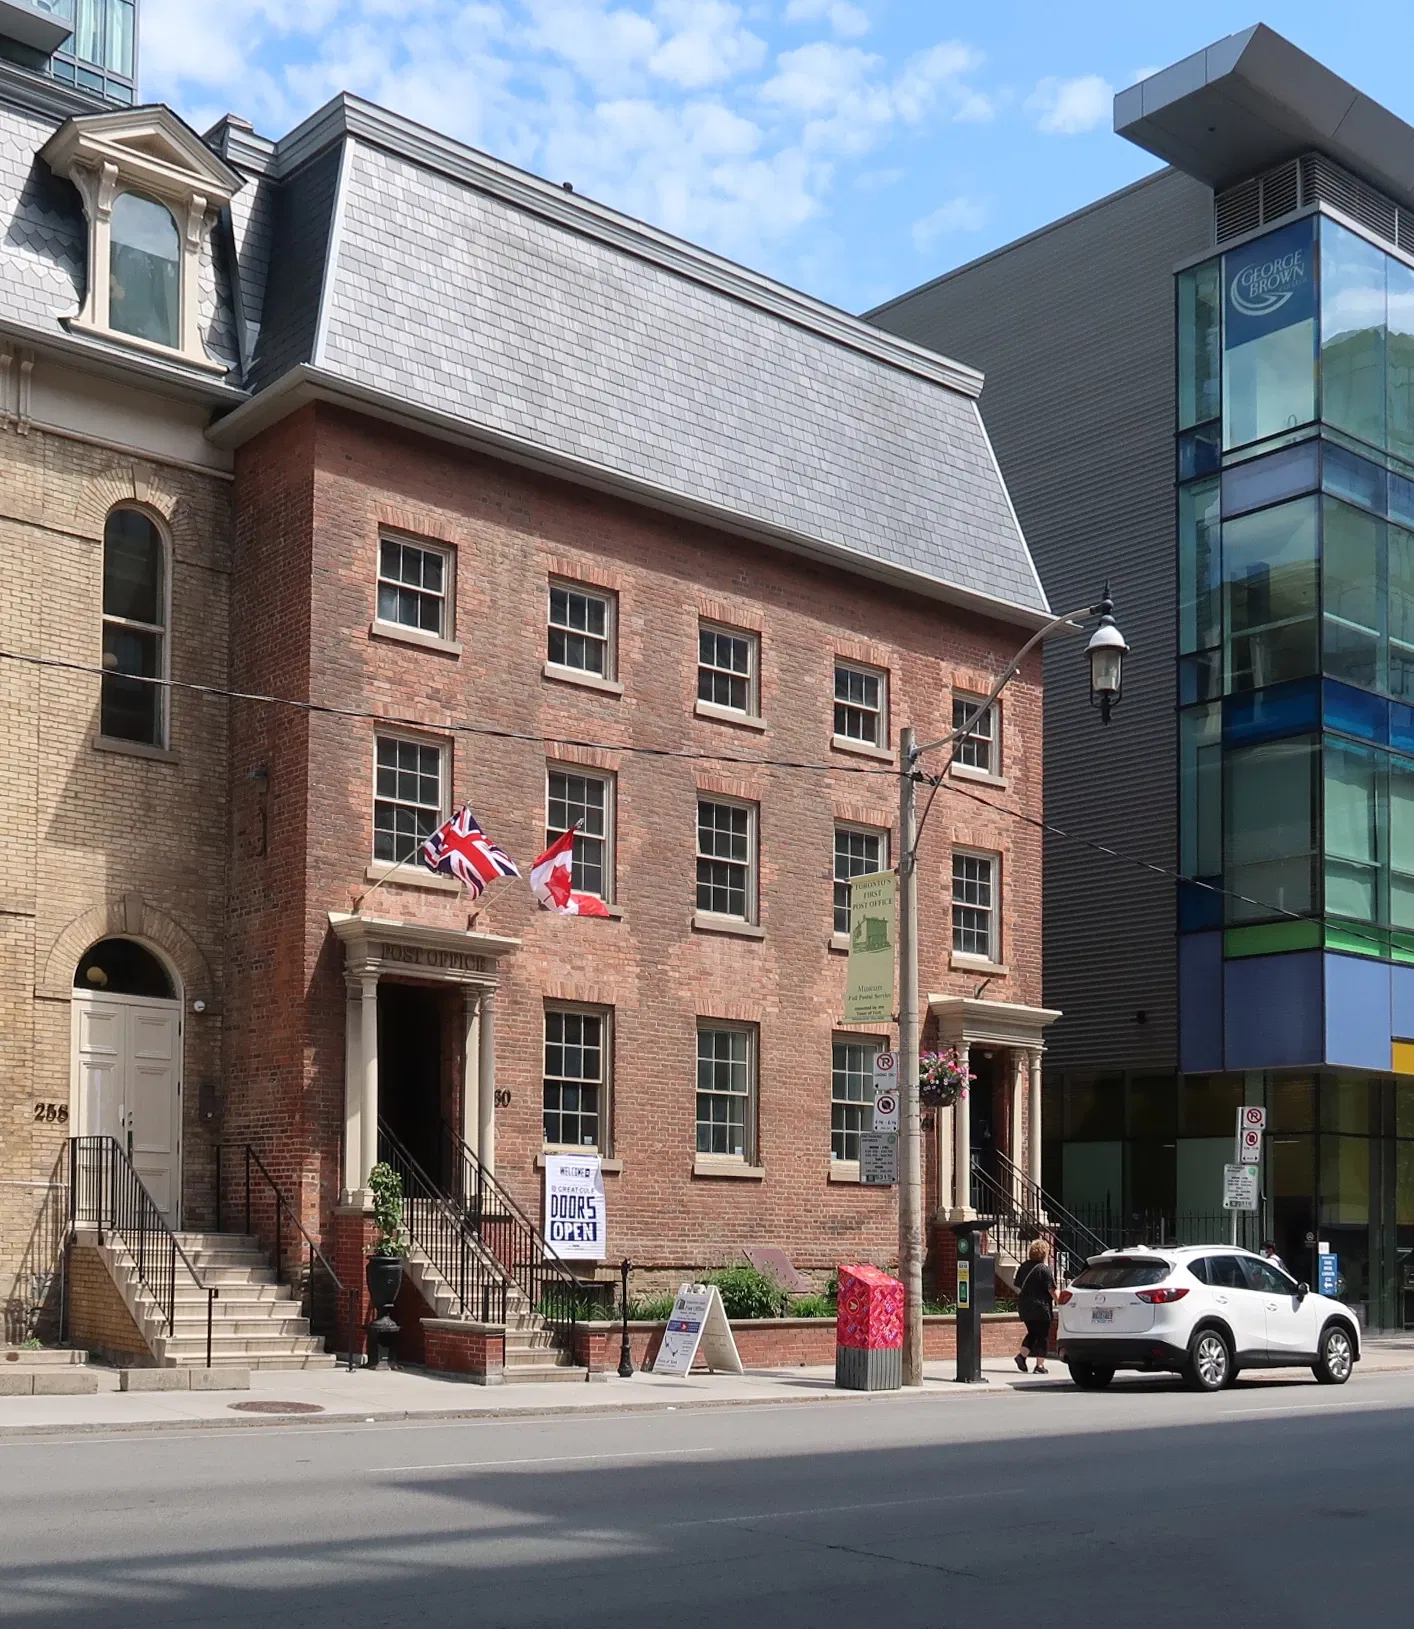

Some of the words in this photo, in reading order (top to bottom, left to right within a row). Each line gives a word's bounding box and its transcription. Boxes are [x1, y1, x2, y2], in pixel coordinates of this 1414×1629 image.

[1241, 249, 1303, 286] GEORGE
[1249, 262, 1305, 298] BROWN
[852, 902, 868, 911] POST
[868, 898, 892, 908] OFFICE
[863, 889, 882, 899] FIRST
[382, 942, 422, 964] POST
[427, 950, 486, 972] OFFICE
[34, 1102, 69, 1124] 258
[560, 1167, 585, 1177] WELCOME
[551, 1194, 597, 1219] DOORS
[552, 1222, 594, 1241] OPEN
